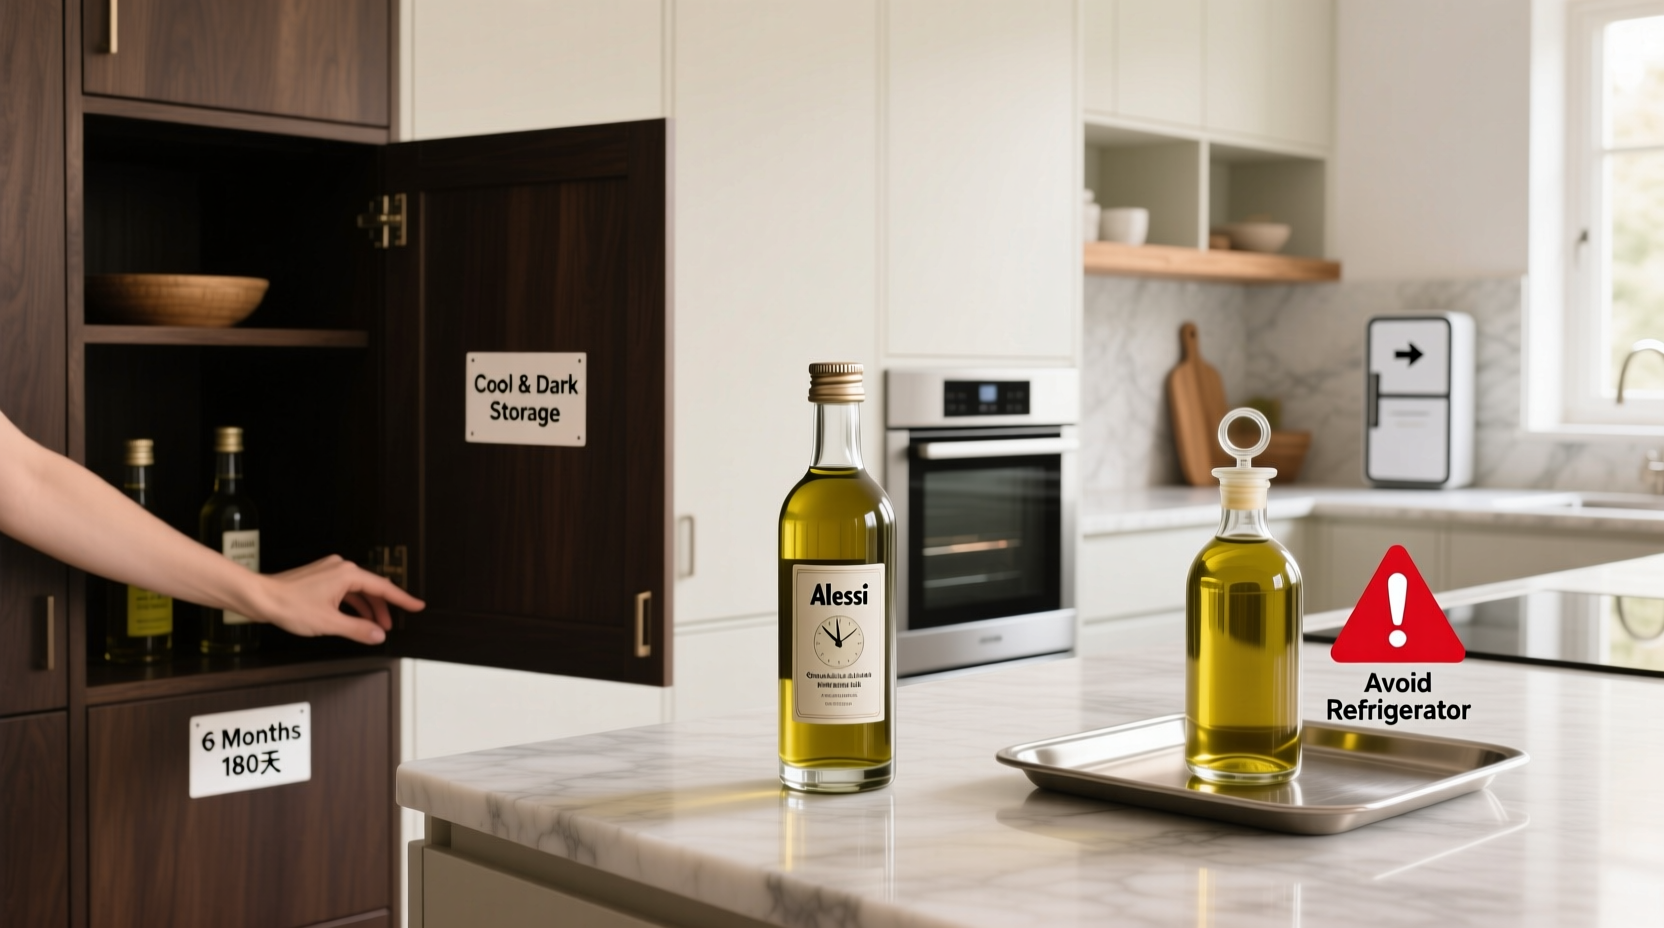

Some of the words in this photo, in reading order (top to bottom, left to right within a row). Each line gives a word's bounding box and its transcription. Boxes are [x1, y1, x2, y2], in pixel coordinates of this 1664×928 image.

[474, 373, 513, 394] Cool
[518, 374, 531, 394] &
[536, 373, 579, 395] Dark
[490, 400, 561, 428] Storage
[810, 582, 869, 606] Alessi
[202, 731, 215, 752] 6
[222, 721, 301, 750] Months
[222, 750, 281, 777] 180天
